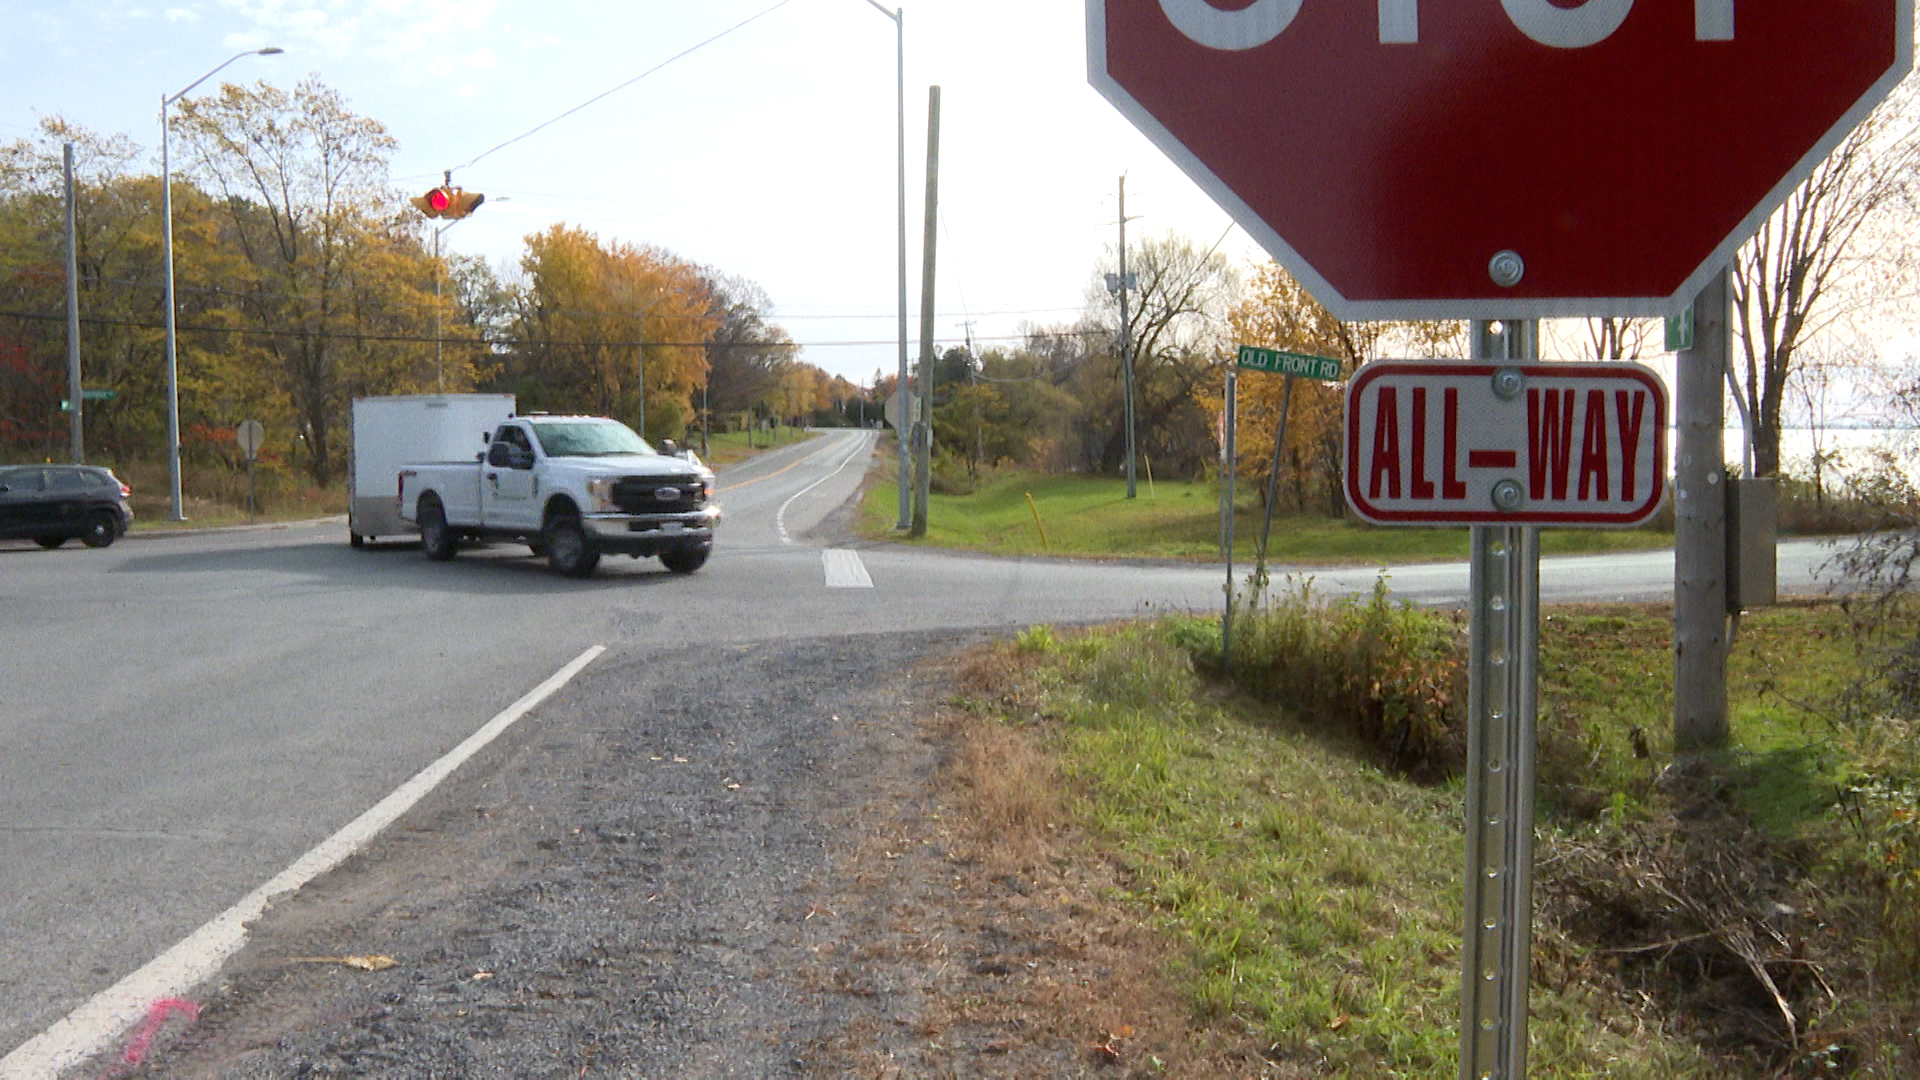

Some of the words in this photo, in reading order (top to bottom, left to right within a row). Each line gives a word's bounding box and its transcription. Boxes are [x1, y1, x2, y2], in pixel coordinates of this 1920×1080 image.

[1241, 349, 1268, 368] OLD
[1274, 354, 1318, 376] FRONT
[1320, 360, 1339, 378] RD
[1369, 387, 1645, 502] ALL-WAY
